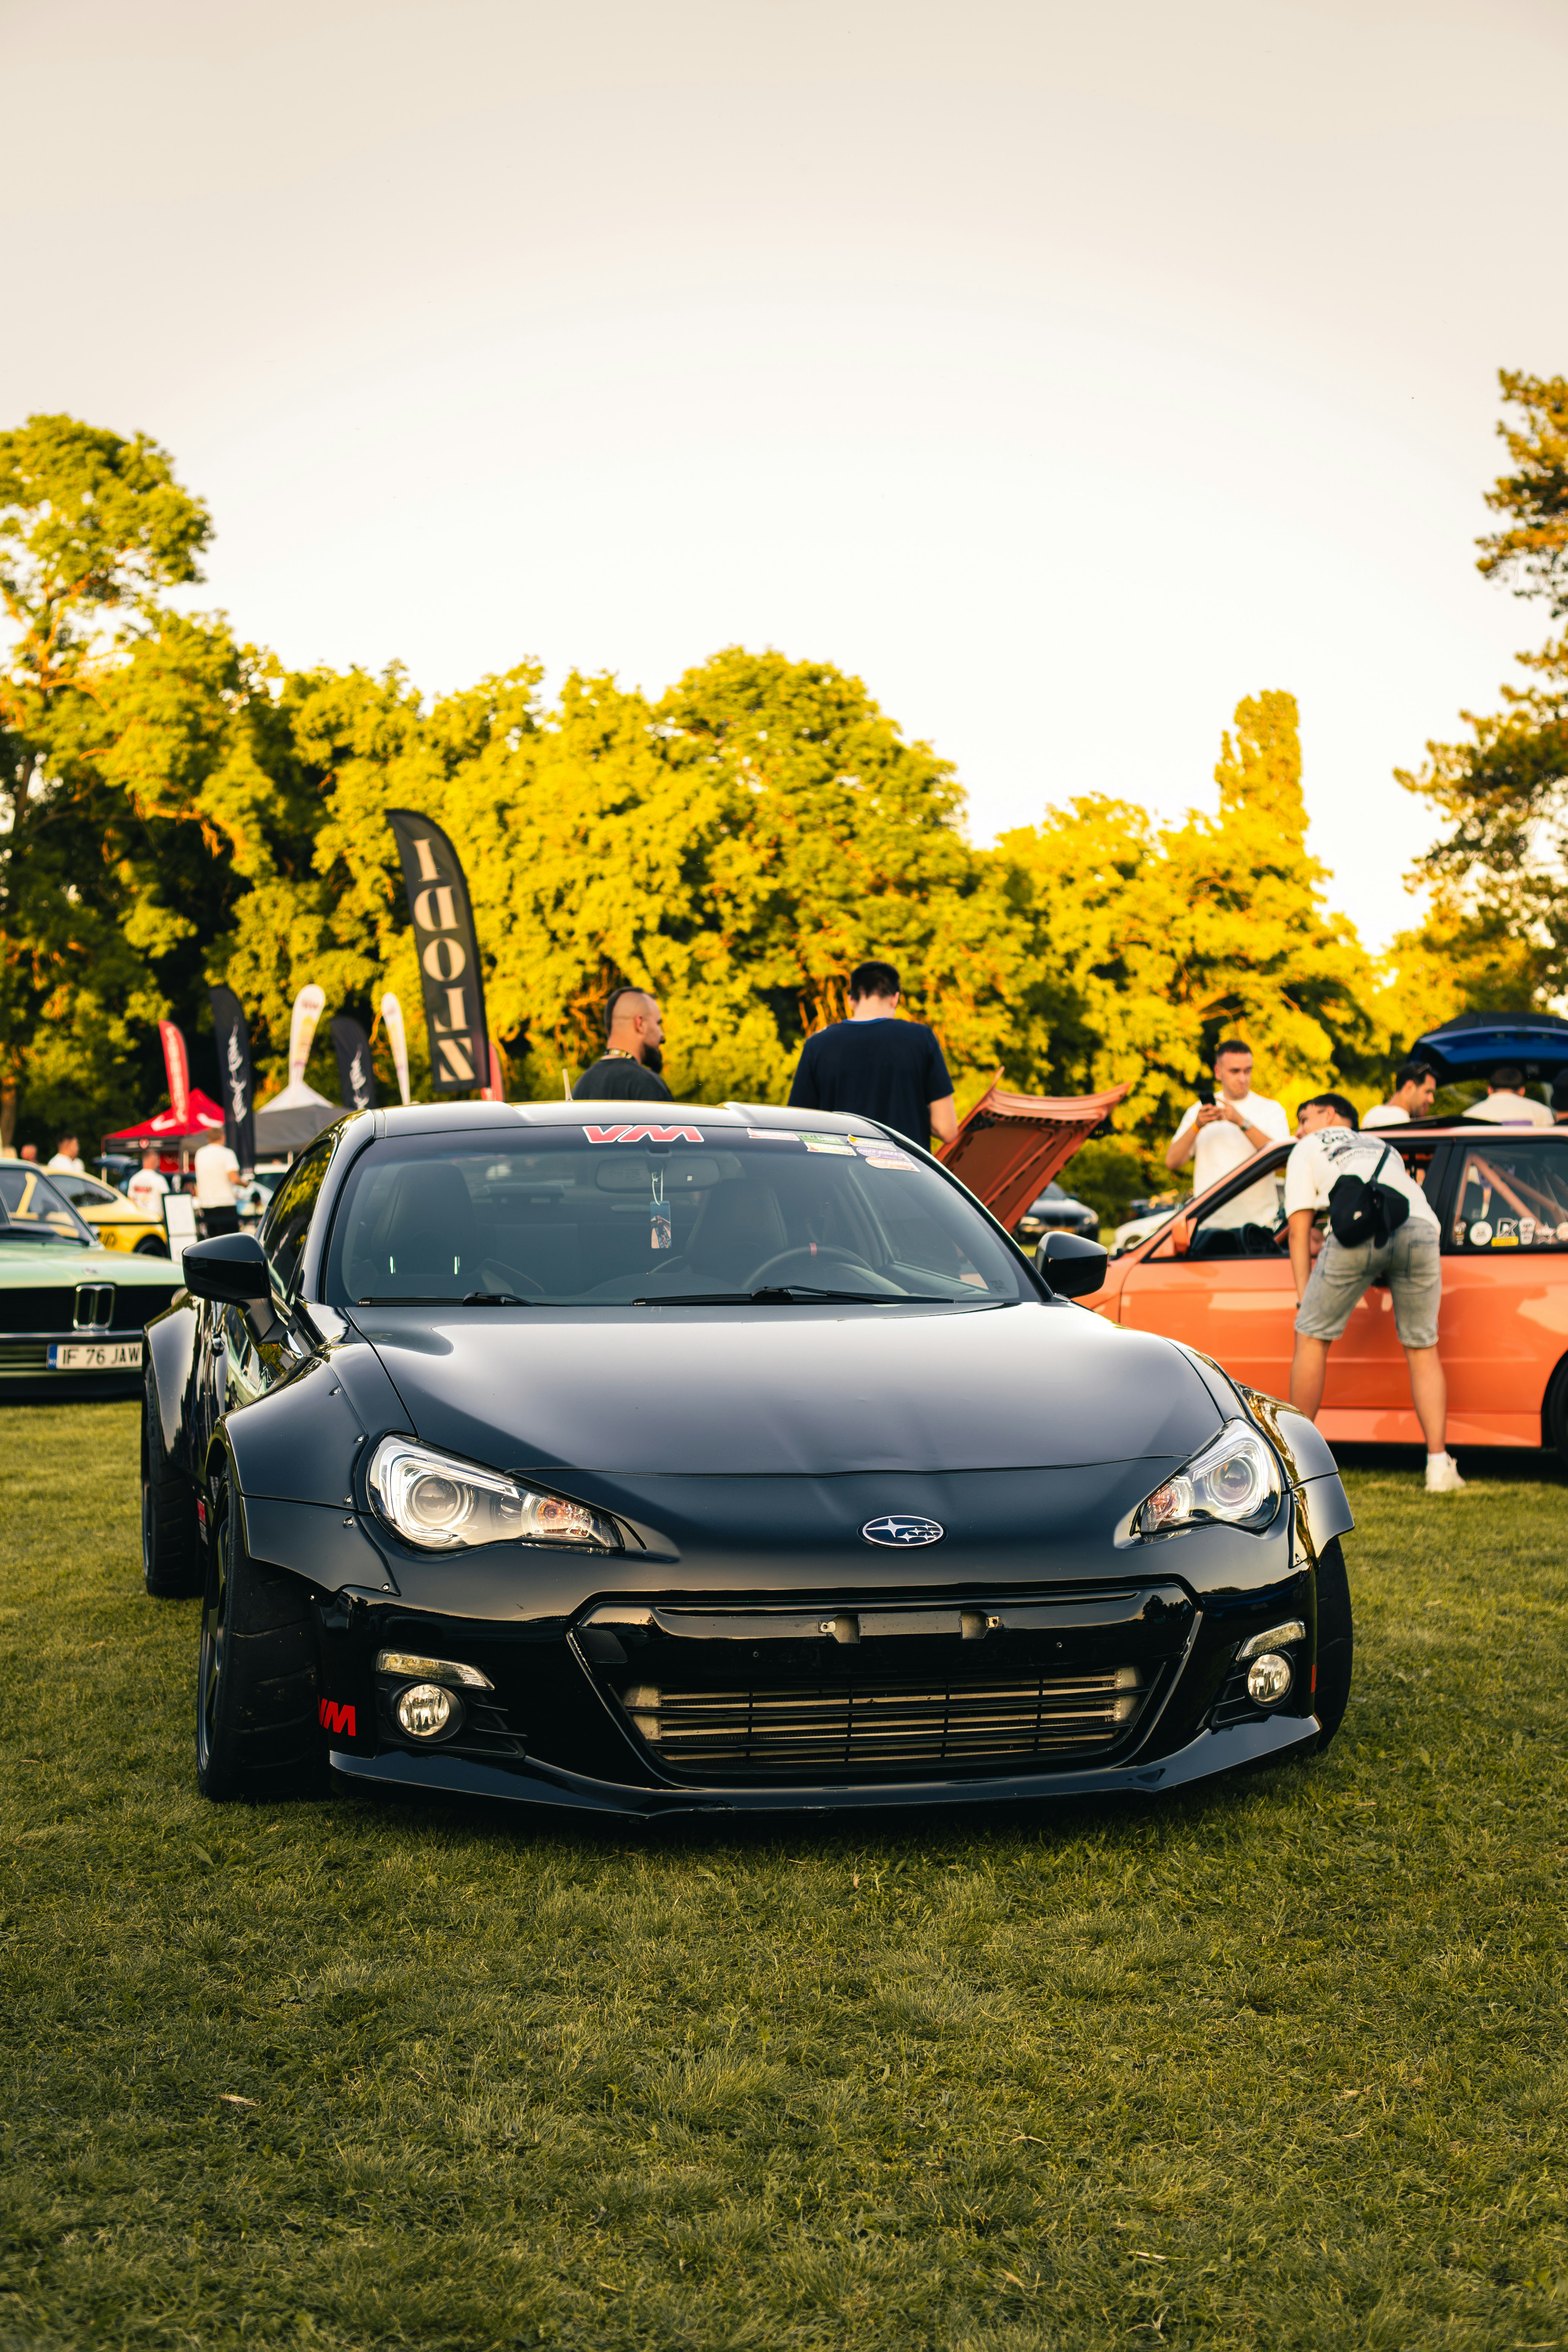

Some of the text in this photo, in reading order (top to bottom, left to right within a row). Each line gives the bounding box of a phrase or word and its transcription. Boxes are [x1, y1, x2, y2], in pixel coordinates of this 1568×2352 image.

[582, 1125, 704, 1143] VM
[63, 1347, 140, 1365] IF 76 JAW
